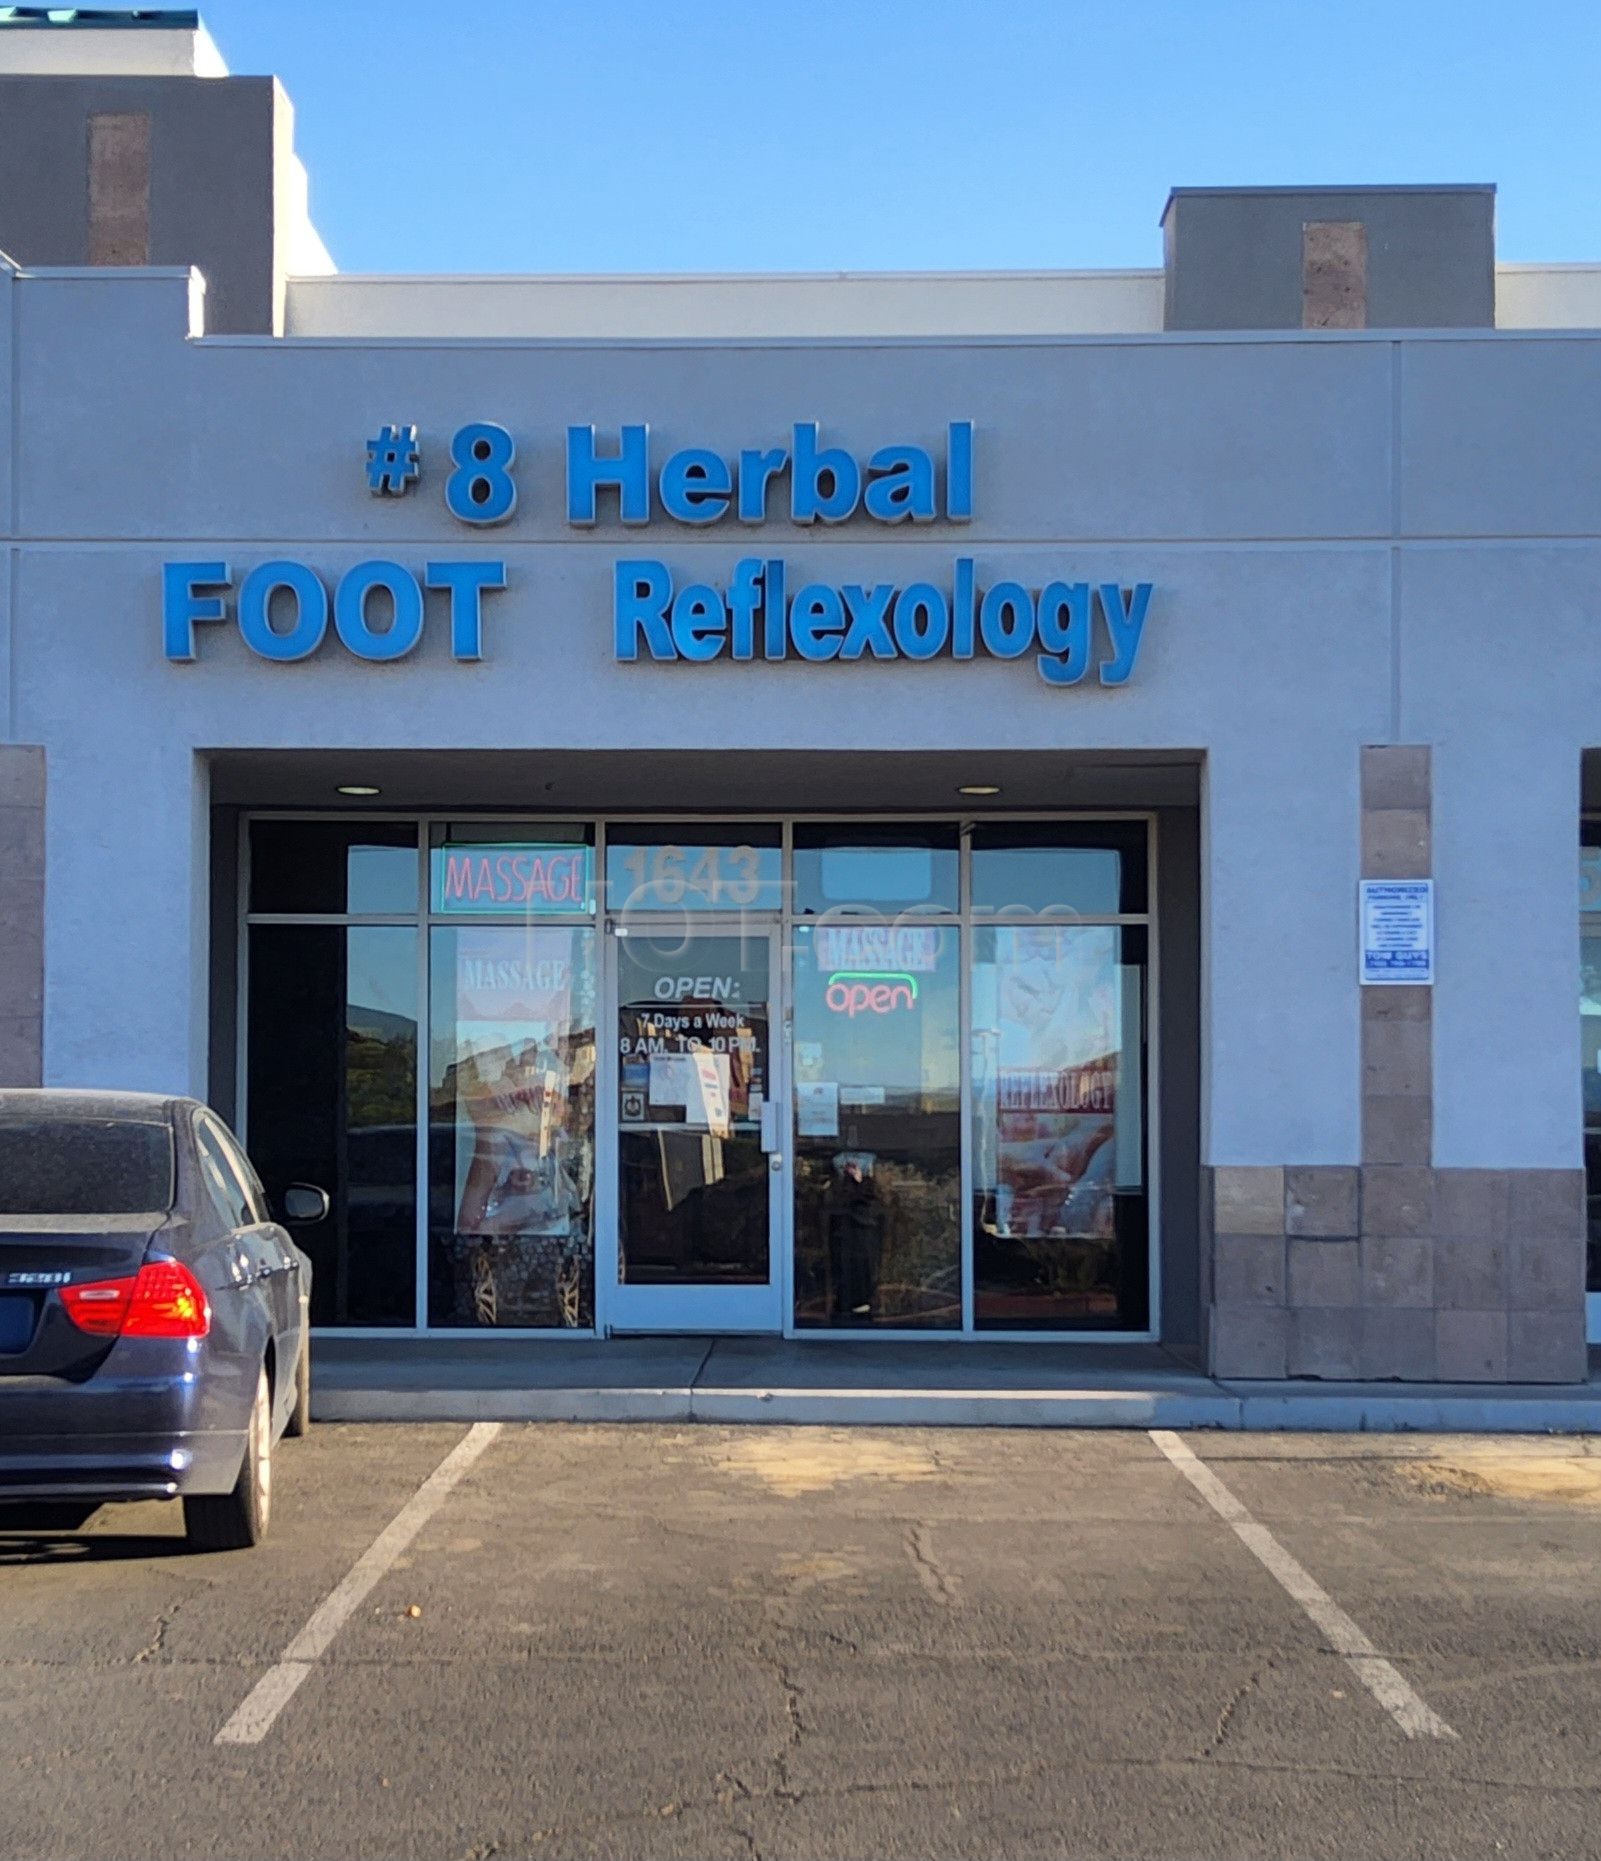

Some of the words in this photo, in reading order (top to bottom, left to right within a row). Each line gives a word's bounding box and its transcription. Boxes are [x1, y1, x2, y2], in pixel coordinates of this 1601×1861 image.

[366, 423, 420, 495] #
[445, 420, 518, 525] 8
[565, 418, 974, 526] Herbal
[162, 561, 508, 663] FOOT
[614, 557, 1152, 688] Reflexology
[445, 855, 583, 902] MASSAGE
[623, 845, 760, 904] 1643
[463, 957, 568, 993] MASSAGE
[654, 976, 741, 999] OPEN:
[826, 983, 914, 1018] open
[641, 1013, 649, 1027] 7
[654, 1013, 690, 1031] Days
[693, 1016, 702, 1028] a
[705, 1012, 744, 1029] Week
[620, 1037, 631, 1053] 8
[679, 1037, 702, 1052] TO
